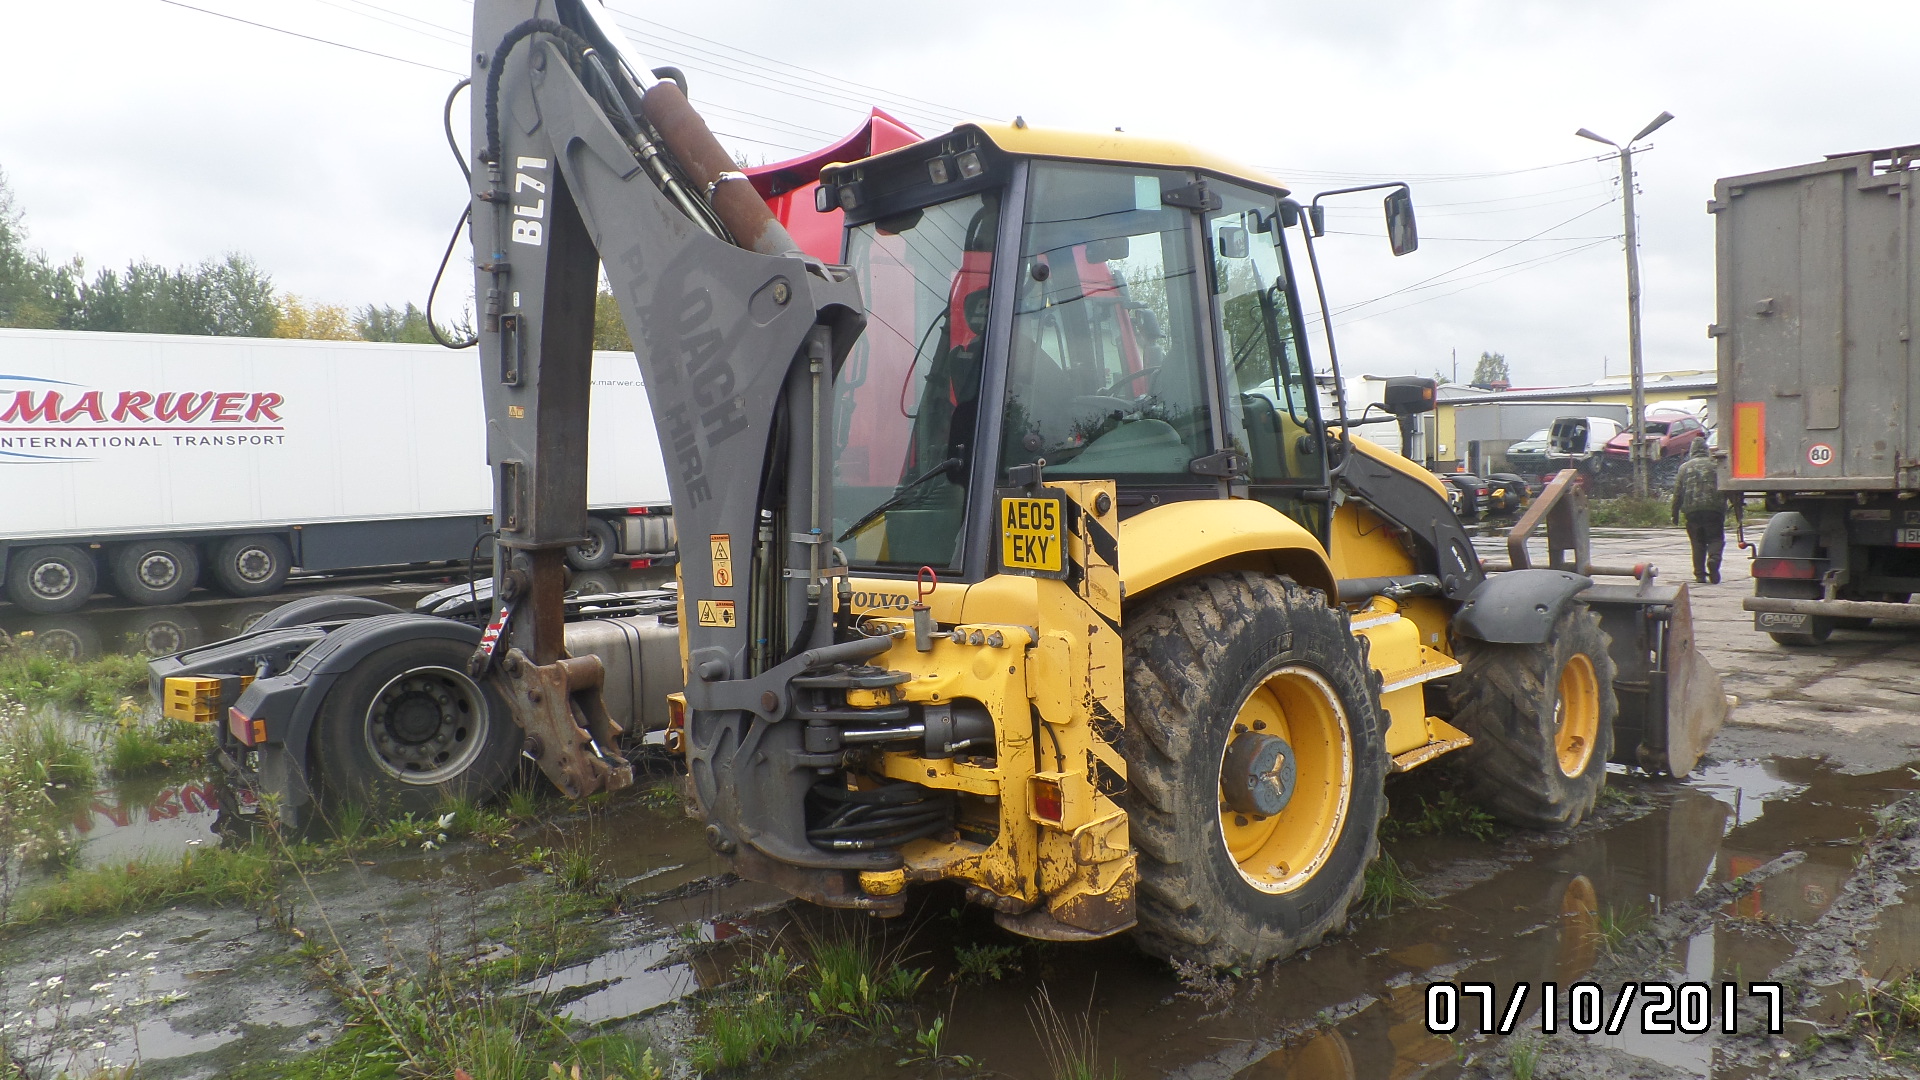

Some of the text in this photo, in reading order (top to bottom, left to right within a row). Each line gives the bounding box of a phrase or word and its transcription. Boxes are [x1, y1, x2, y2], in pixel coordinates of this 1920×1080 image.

[511, 156, 548, 246] BL71
[0, 390, 284, 423] MARWER
[1, 435, 285, 448] NTERNATIONAL TRANSPORT
[666, 402, 713, 509] HIRE
[1811, 449, 1829, 461] 80
[1006, 501, 1055, 530] AE05
[1013, 535, 1049, 564] EKY
[1764, 613, 1807, 624] PANAV
